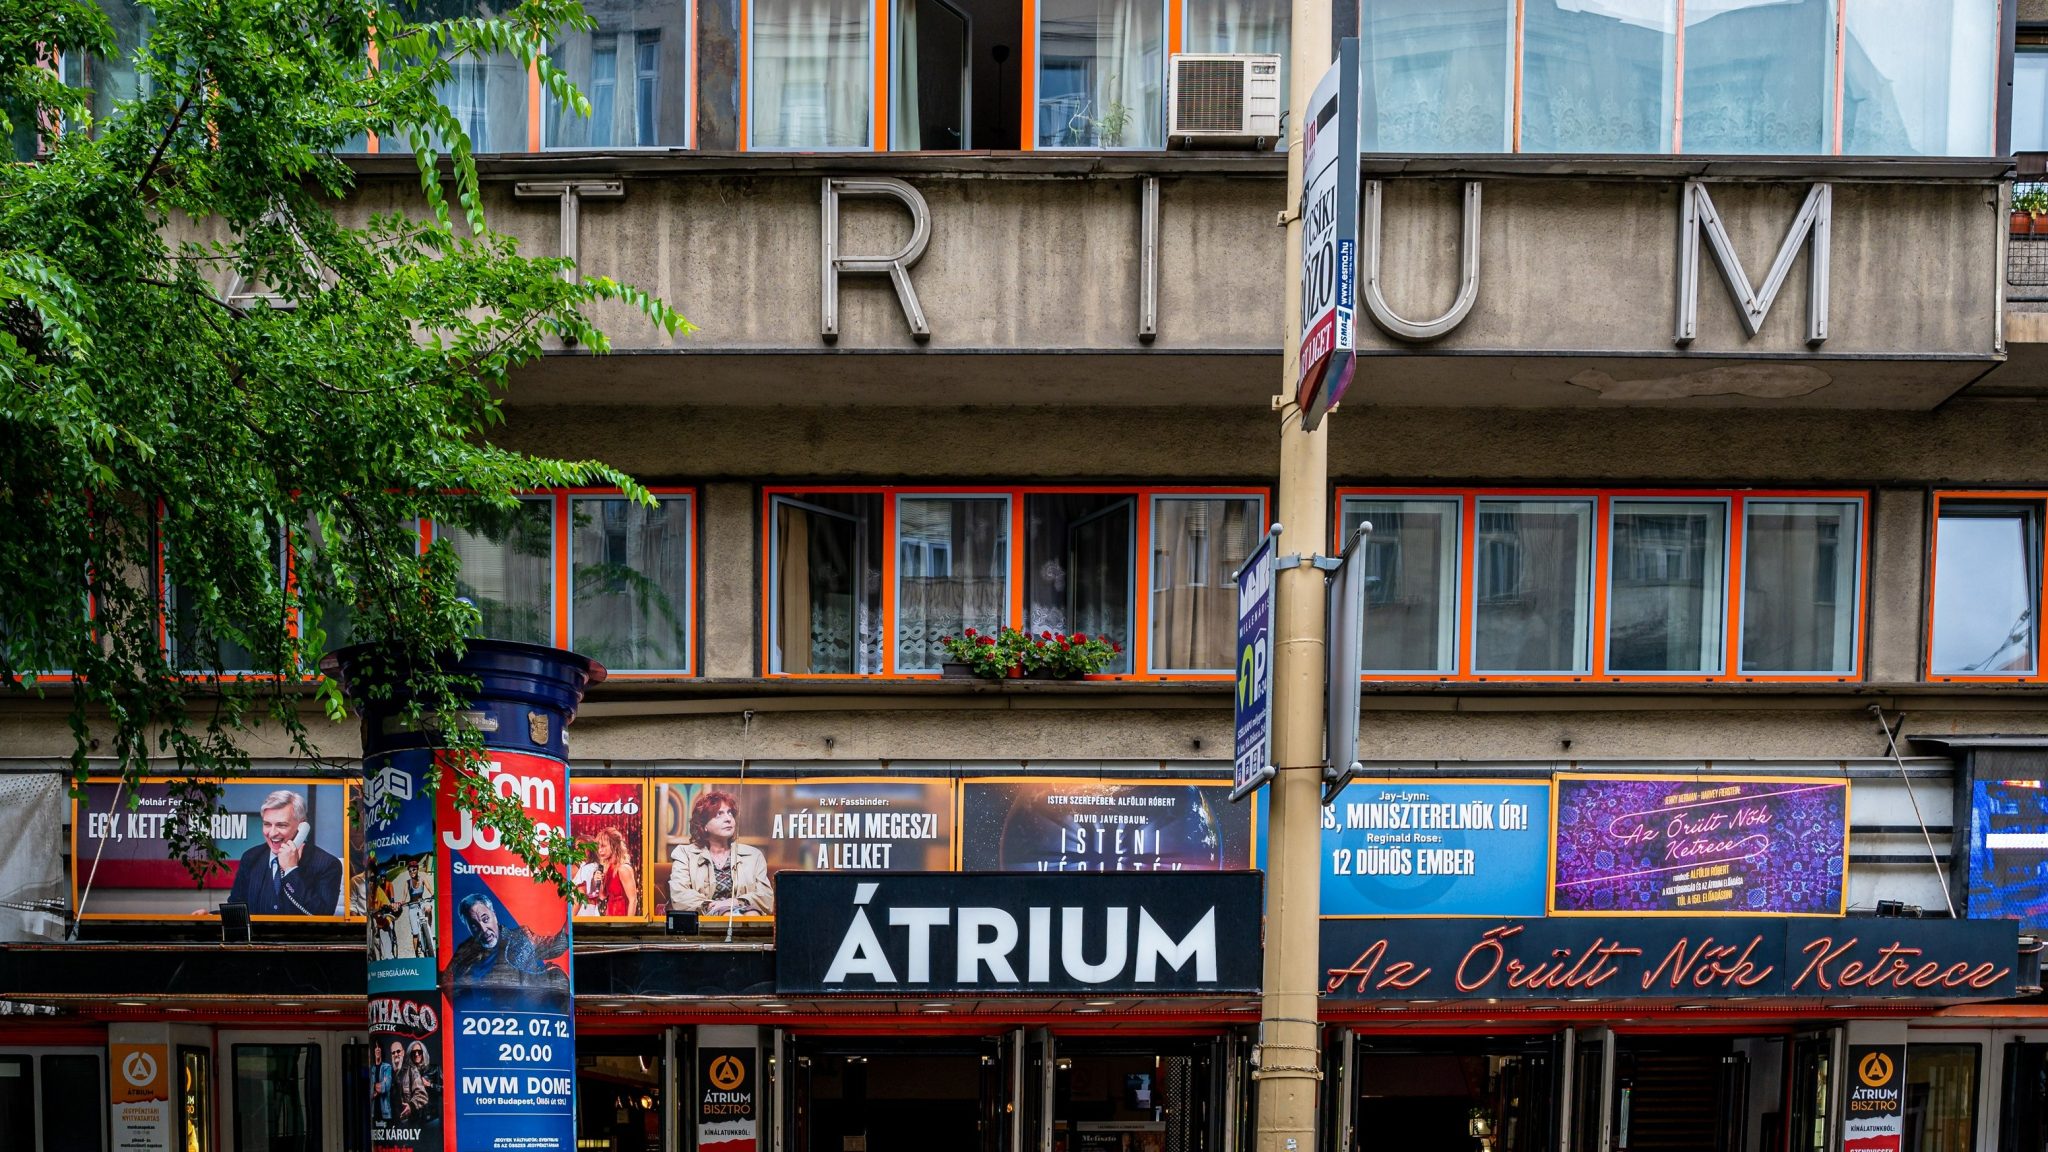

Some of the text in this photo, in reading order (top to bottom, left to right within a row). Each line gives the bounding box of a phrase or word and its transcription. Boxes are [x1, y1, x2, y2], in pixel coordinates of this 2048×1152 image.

[1341, 241, 1350, 305] www.esma.hu
[1340, 321, 1348, 347] ESMA
[1308, 321, 1333, 370] LIGET
[465, 761, 556, 813] Tom
[138, 797, 166, 807] Molnár
[569, 796, 639, 815] fisztó
[819, 798, 890, 807] R.W. Fassbinder:
[1047, 794, 1176, 807] ISTEN SZEREPÉBEN: ALFÖLDI RÓBERT
[1073, 814, 1149, 825] DAVID JAVERBAUM:
[1346, 800, 1494, 830] MINISZTERELNÖK
[1499, 799, 1528, 830] ÚR!
[88, 813, 123, 843] EGY,
[772, 809, 938, 840] A FÉLELEM MEGESZI
[1623, 805, 1773, 846] Az Őrült Nők
[1061, 827, 1160, 855] ISTENI
[1366, 833, 1442, 844] Reginald Rose:
[817, 843, 893, 869] A LELKET
[1664, 839, 1736, 861] Ketrece
[453, 861, 529, 878] Surrounded
[1332, 845, 1475, 875] 12 DÜHÖS EMBER
[1690, 867, 1710, 879] ALFÖLDI
[1710, 864, 1730, 877] RÓBERT
[1677, 894, 1687, 906] TÚL
[822, 882, 1217, 984] ÁTRIUM
[1326, 924, 2010, 993] Az Őrült Nők Ketrece
[462, 1017, 570, 1038] 2022. 07. 12.
[498, 1043, 552, 1062] 20.00
[462, 1076, 571, 1095] MVM DOME
[1851, 1086, 1898, 1100] ÁTRIUM
[475, 1097, 496, 1105] (1091
[497, 1097, 535, 1106] Budapest,
[703, 1089, 751, 1103] ÁTRIUM
[1851, 1099, 1897, 1111] BISZTRÓ
[703, 1101, 751, 1115] BISZTRÓ
[385, 1125, 421, 1141] KÁROLY
[704, 1128, 751, 1136] KÍNÁLATUNKBÓL:
[1850, 1124, 1896, 1132] KÍNÁLATUNKBÓL:
